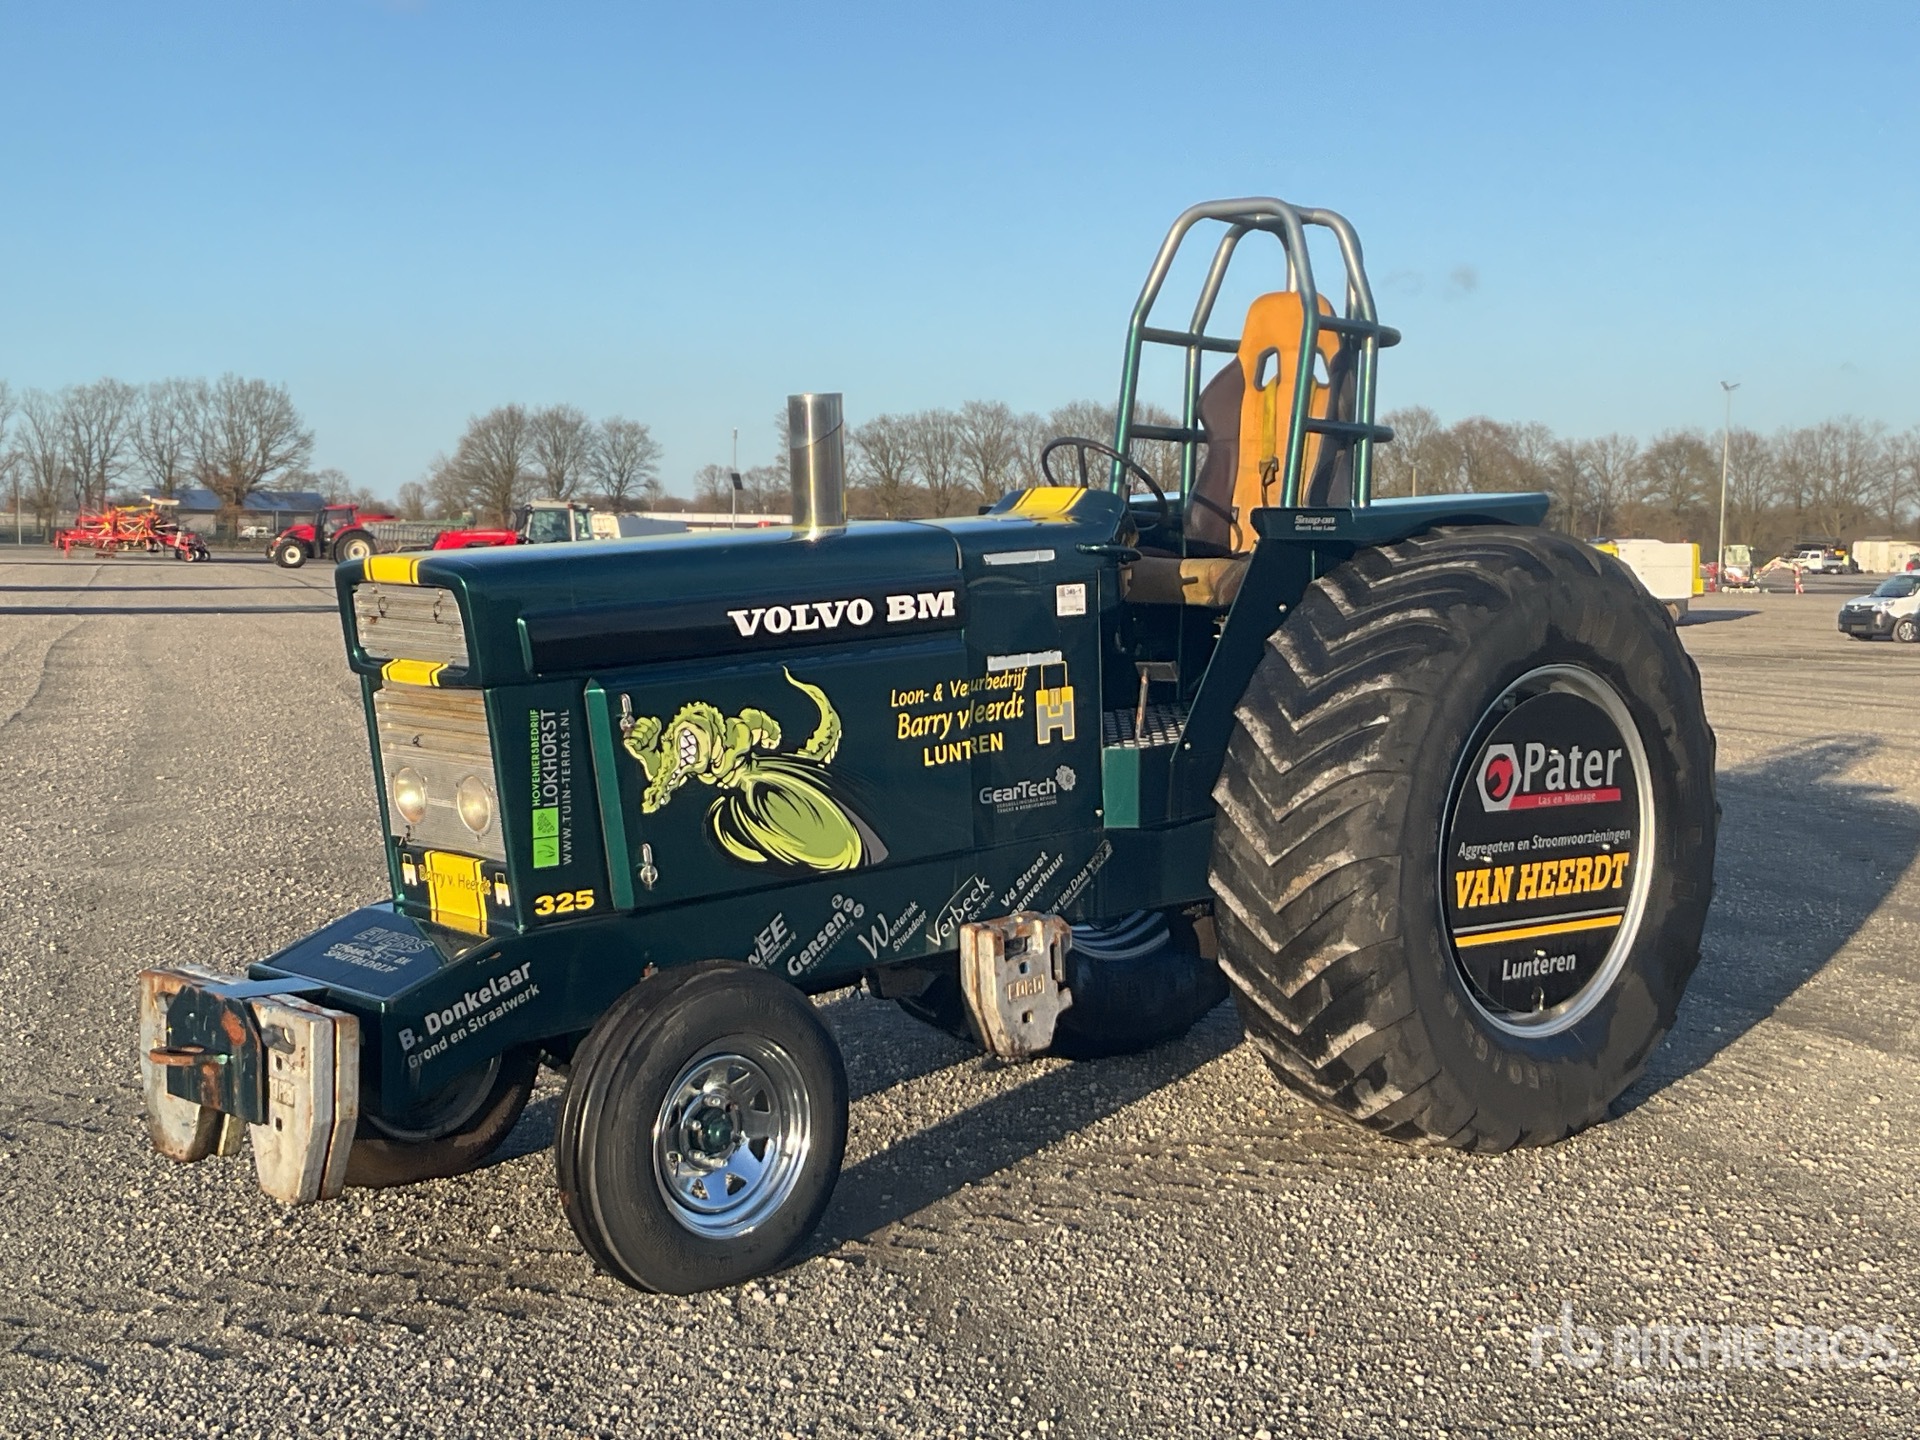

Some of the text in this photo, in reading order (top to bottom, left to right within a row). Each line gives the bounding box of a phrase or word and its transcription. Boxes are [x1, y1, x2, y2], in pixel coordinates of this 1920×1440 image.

[727, 591, 956, 637] VOLVO BM
[891, 689, 930, 708] Loon-
[933, 683, 943, 702] &
[898, 711, 953, 741] Barry
[530, 709, 540, 807] HOVENIERSBEDRIJF
[541, 709, 558, 808] LOKHORST
[1522, 742, 1622, 793] Pater
[562, 709, 573, 866] WWW.TUIN-TERRAS.NL
[979, 778, 1056, 804] GearTech
[1538, 792, 1596, 805] Las en Montage
[1458, 828, 1631, 860] Aggregaten en Stroomvoorzieningen
[535, 889, 595, 916] 325
[1000, 851, 1048, 907] Vd Stroet
[1456, 865, 1515, 909] VAN
[1516, 852, 1630, 901] HEERDT
[926, 873, 990, 946] Verbeek
[1502, 953, 1576, 981] Lunteren
[398, 962, 531, 1051] B. Donkelaar
[407, 984, 540, 1069] Grond en Straatwerk
